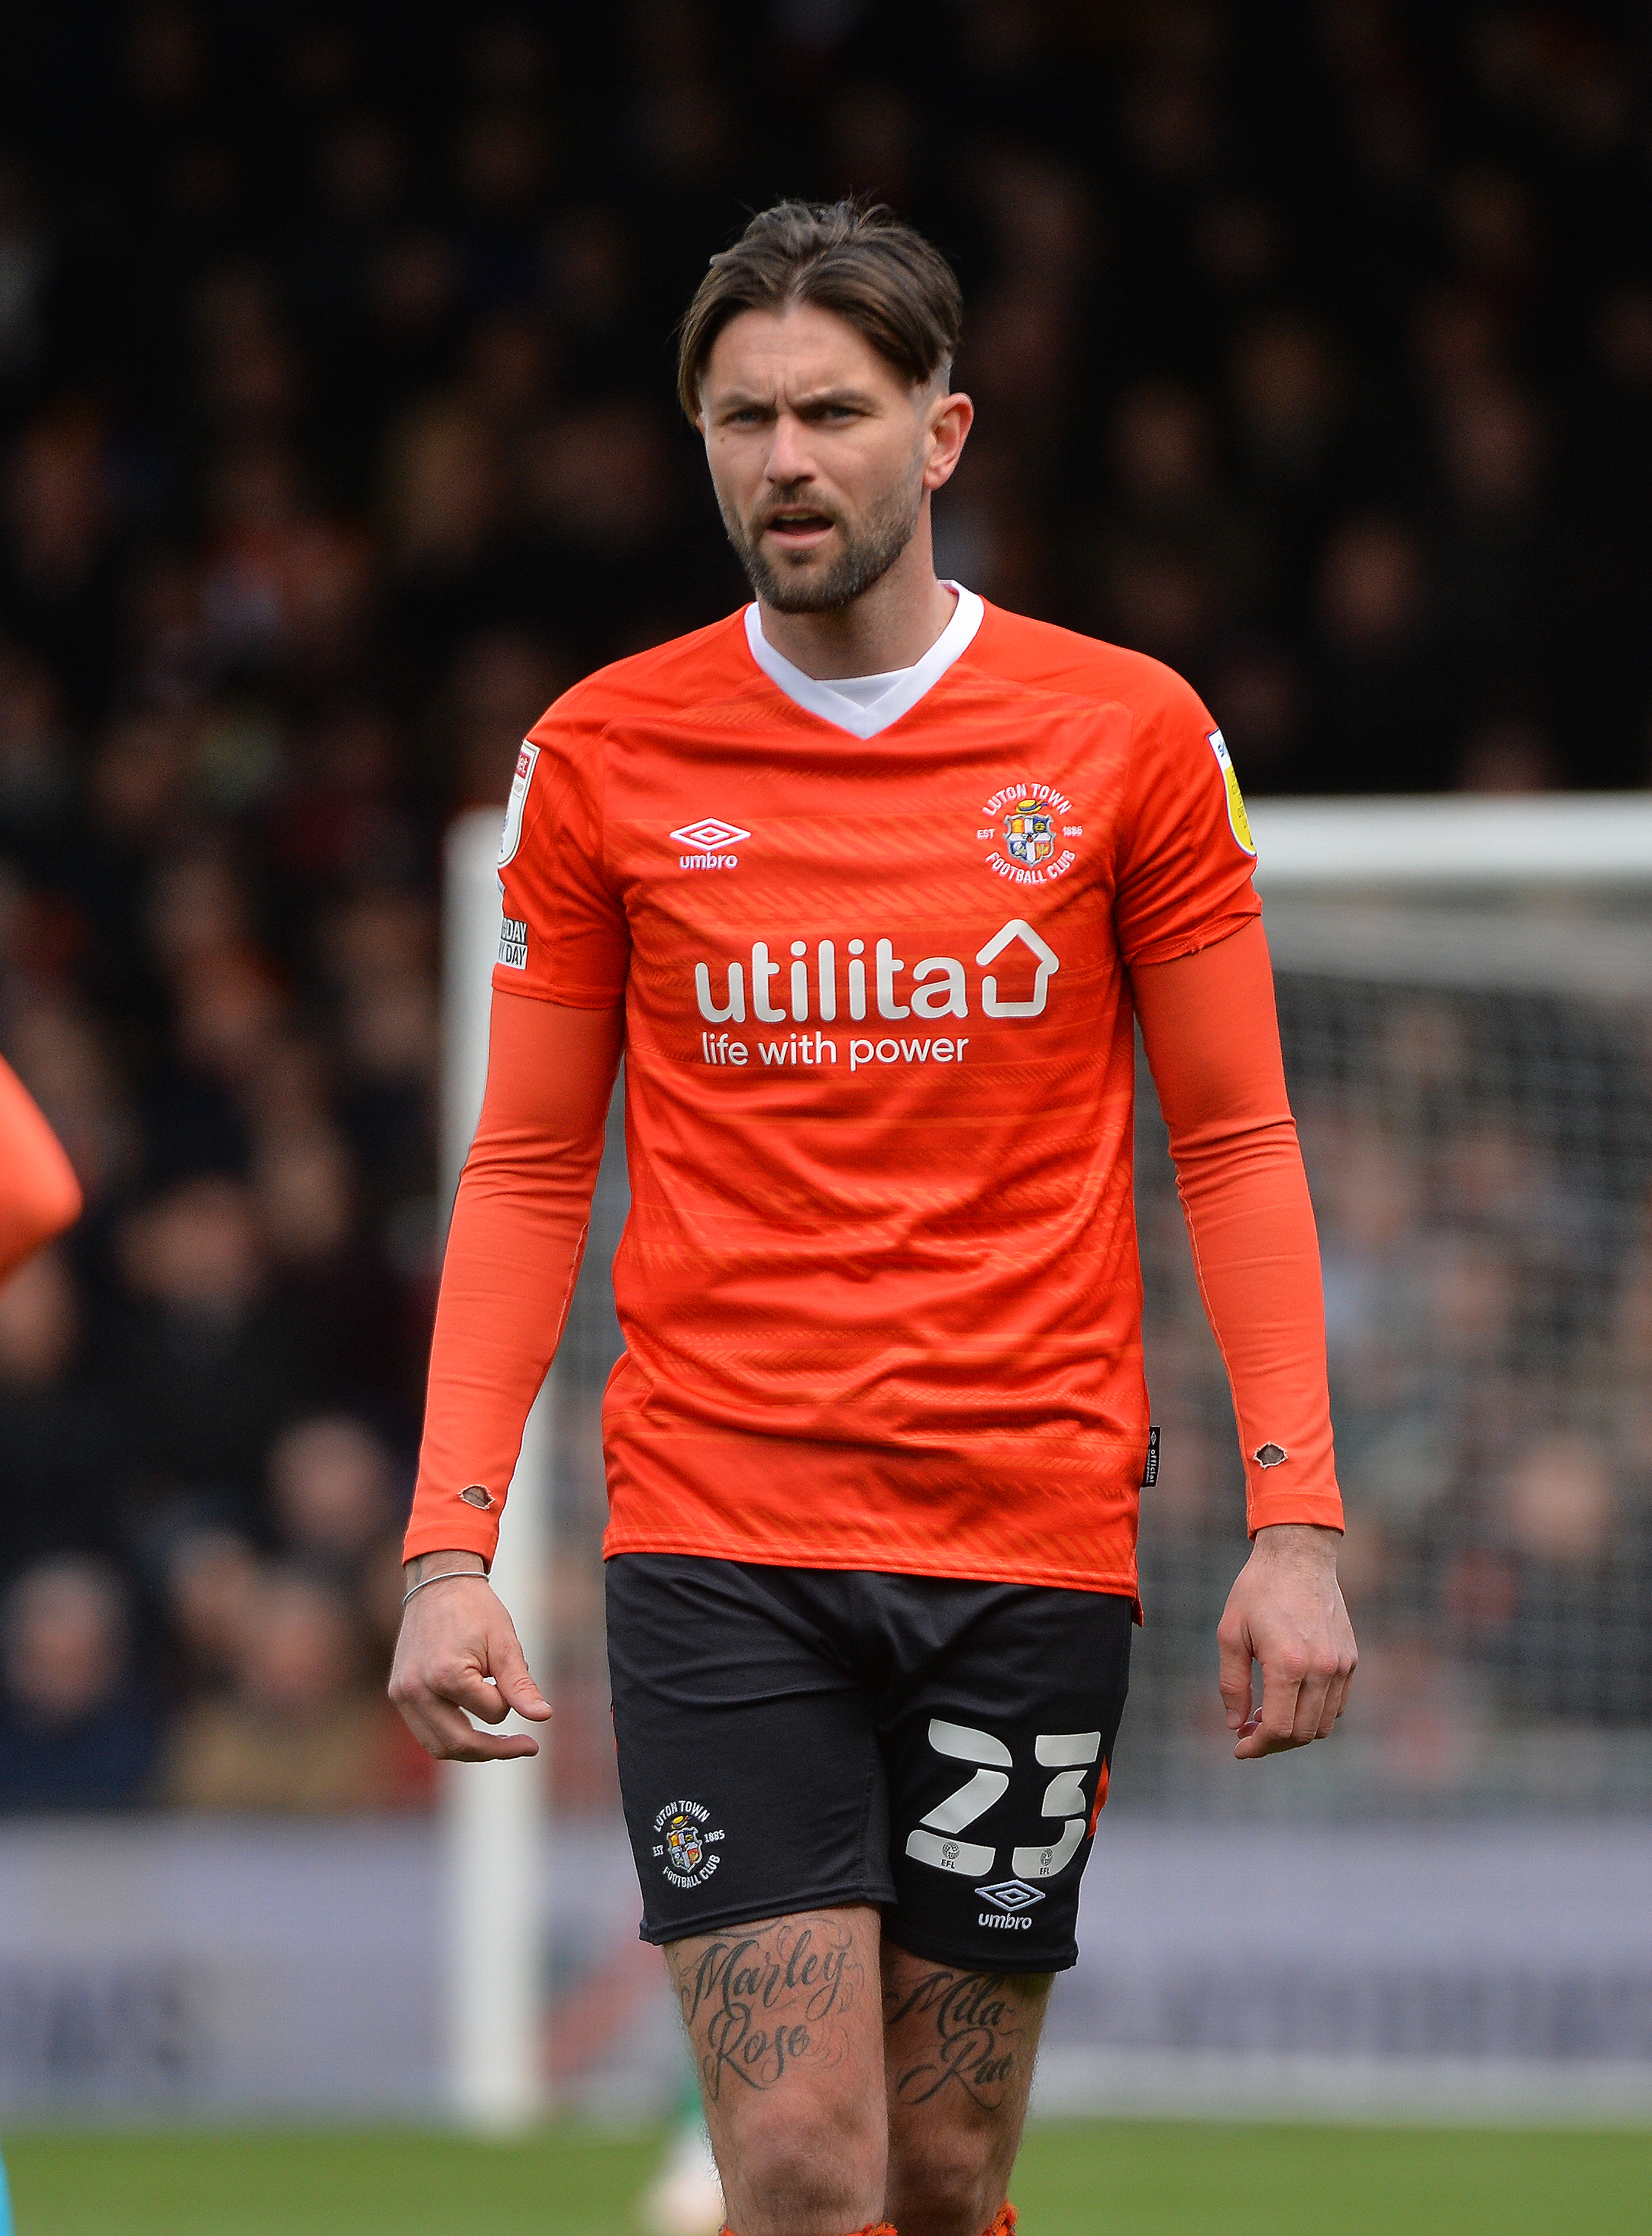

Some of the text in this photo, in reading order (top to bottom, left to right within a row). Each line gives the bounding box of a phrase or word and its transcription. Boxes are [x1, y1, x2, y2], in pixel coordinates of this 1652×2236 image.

[982, 783, 1073, 816] LUTON TOWN
[976, 828, 995, 840] EST
[679, 851, 738, 870] umbro
[985, 850, 1076, 884] FOOTBALL CLUB
[695, 937, 969, 1023] utilita
[702, 1031, 970, 1072] life with power
[905, 1718, 1101, 1879] 23
[653, 1800, 711, 1832] LUTON TOWN
[703, 1829, 725, 1843] 1885
[662, 1854, 721, 1889] FOOTBALL CLUB
[941, 1859, 956, 1869] EFL
[1039, 1867, 1050, 1876] EFL
[978, 1913, 1032, 1930] umbro
[680, 1928, 849, 2025] Marley
[702, 2002, 811, 2101] Rose
